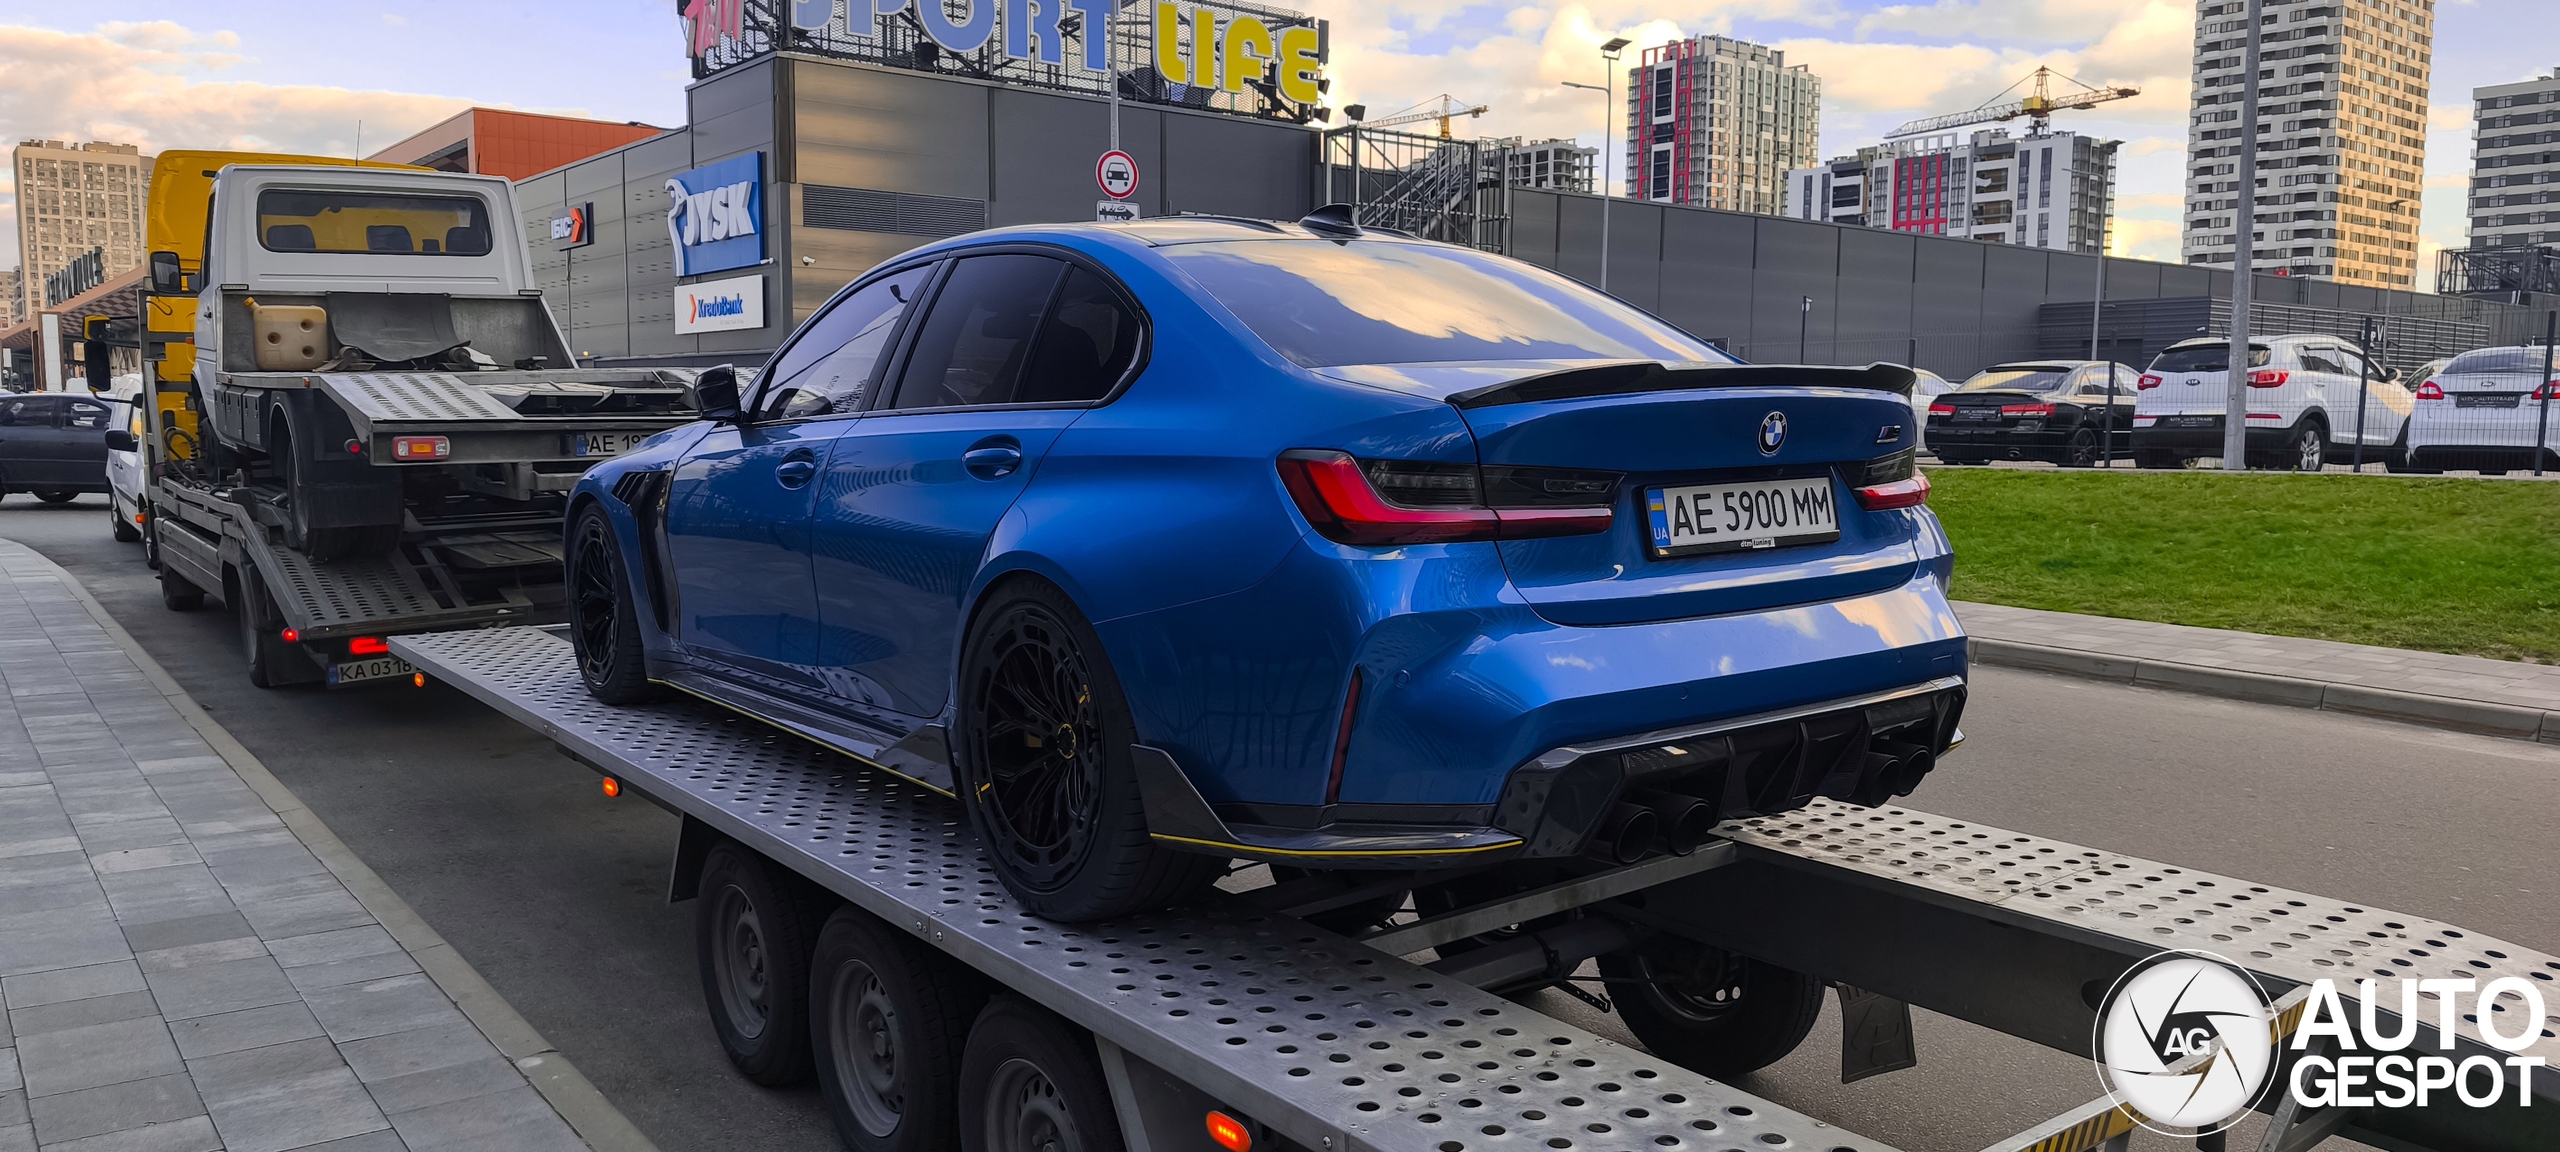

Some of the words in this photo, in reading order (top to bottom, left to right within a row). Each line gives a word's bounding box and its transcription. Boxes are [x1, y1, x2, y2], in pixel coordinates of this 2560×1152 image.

[1152, 1, 1319, 105] LIFE
[683, 181, 755, 246] JYSK
[698, 293, 743, 317] KredoBank
[589, 435, 615, 452] AE
[1673, 493, 1717, 537] AE
[1722, 488, 1787, 532] 5900
[1791, 486, 1832, 526] MM
[1654, 527, 1669, 541] UA
[340, 664, 366, 680] KA
[371, 661, 412, 676] 0318
